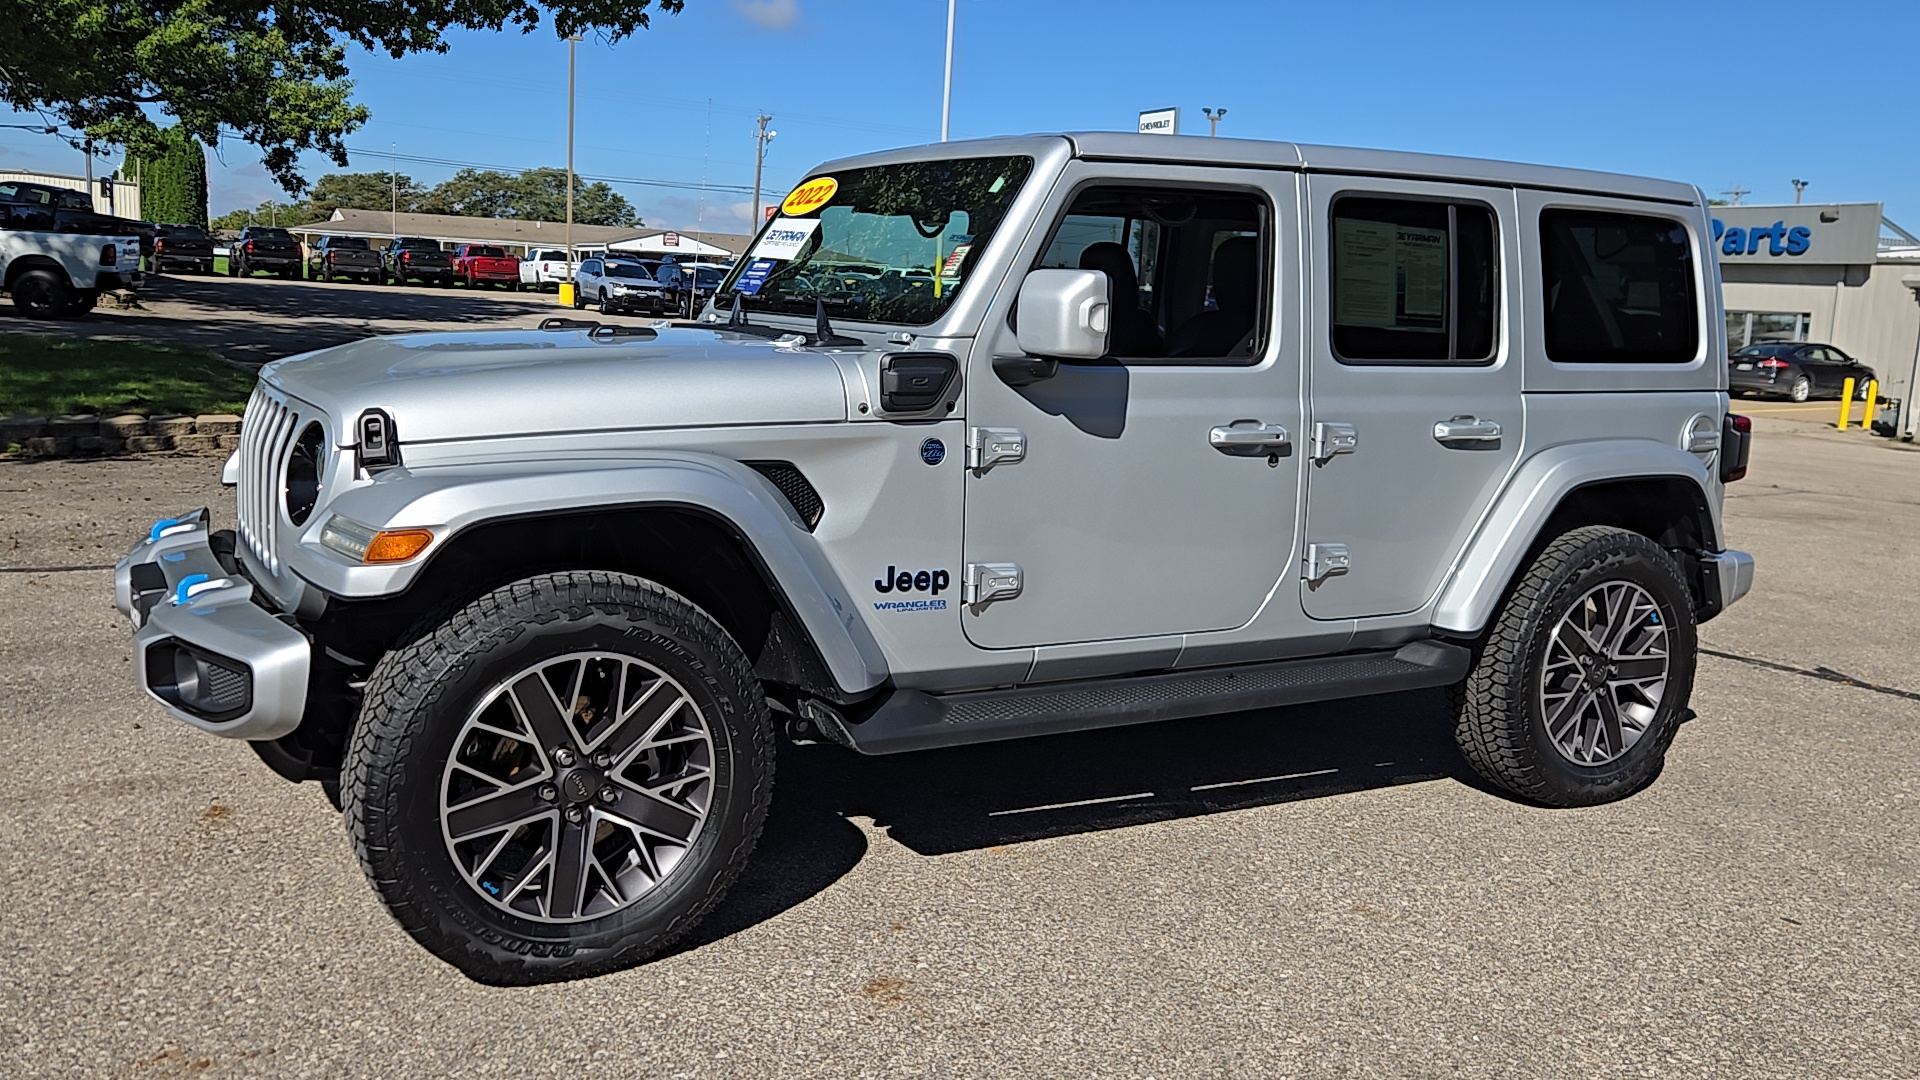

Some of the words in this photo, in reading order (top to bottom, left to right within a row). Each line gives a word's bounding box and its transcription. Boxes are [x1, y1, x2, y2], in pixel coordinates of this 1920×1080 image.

[1141, 120, 1170, 131] CHEVROLET
[786, 184, 834, 206] 2022
[765, 229, 809, 243] DEYARMAN
[874, 565, 950, 596] Jeep
[873, 600, 947, 610] WRANGLER
[896, 605, 948, 613] UNLIMITED
